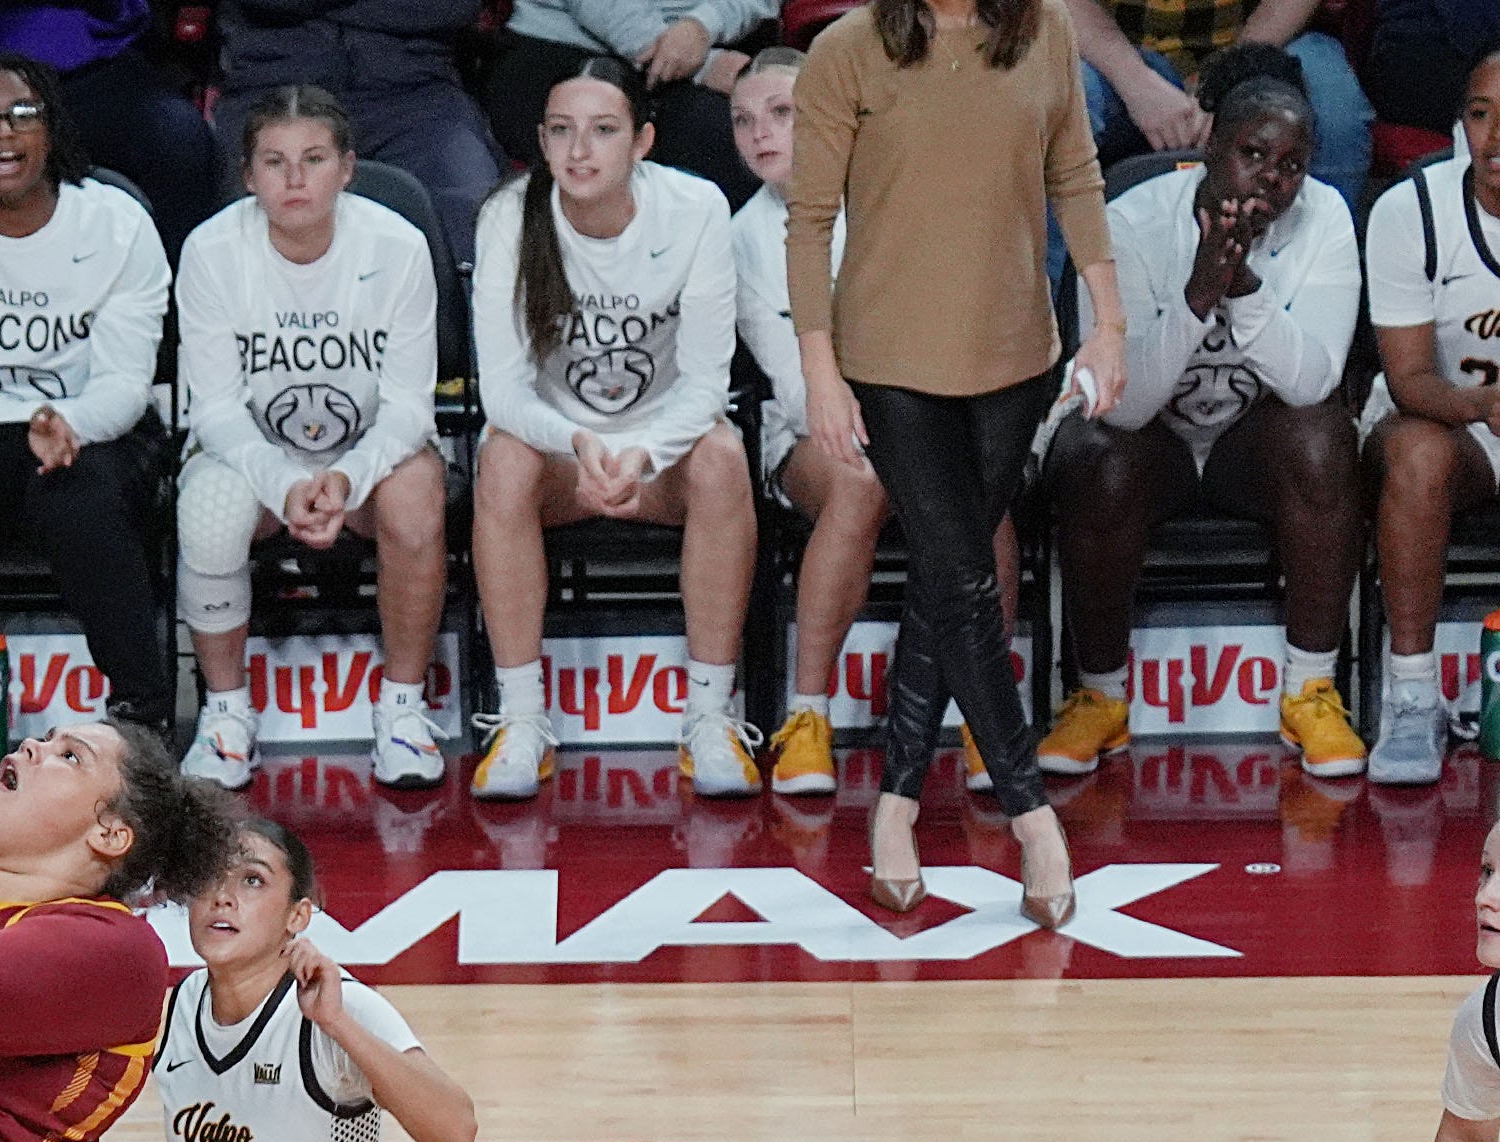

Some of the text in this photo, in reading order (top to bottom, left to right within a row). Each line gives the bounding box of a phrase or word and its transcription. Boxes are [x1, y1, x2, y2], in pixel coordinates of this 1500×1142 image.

[275, 310, 339, 329] VALPO
[542, 653, 690, 731] yVe
[1128, 643, 1280, 724] yVe
